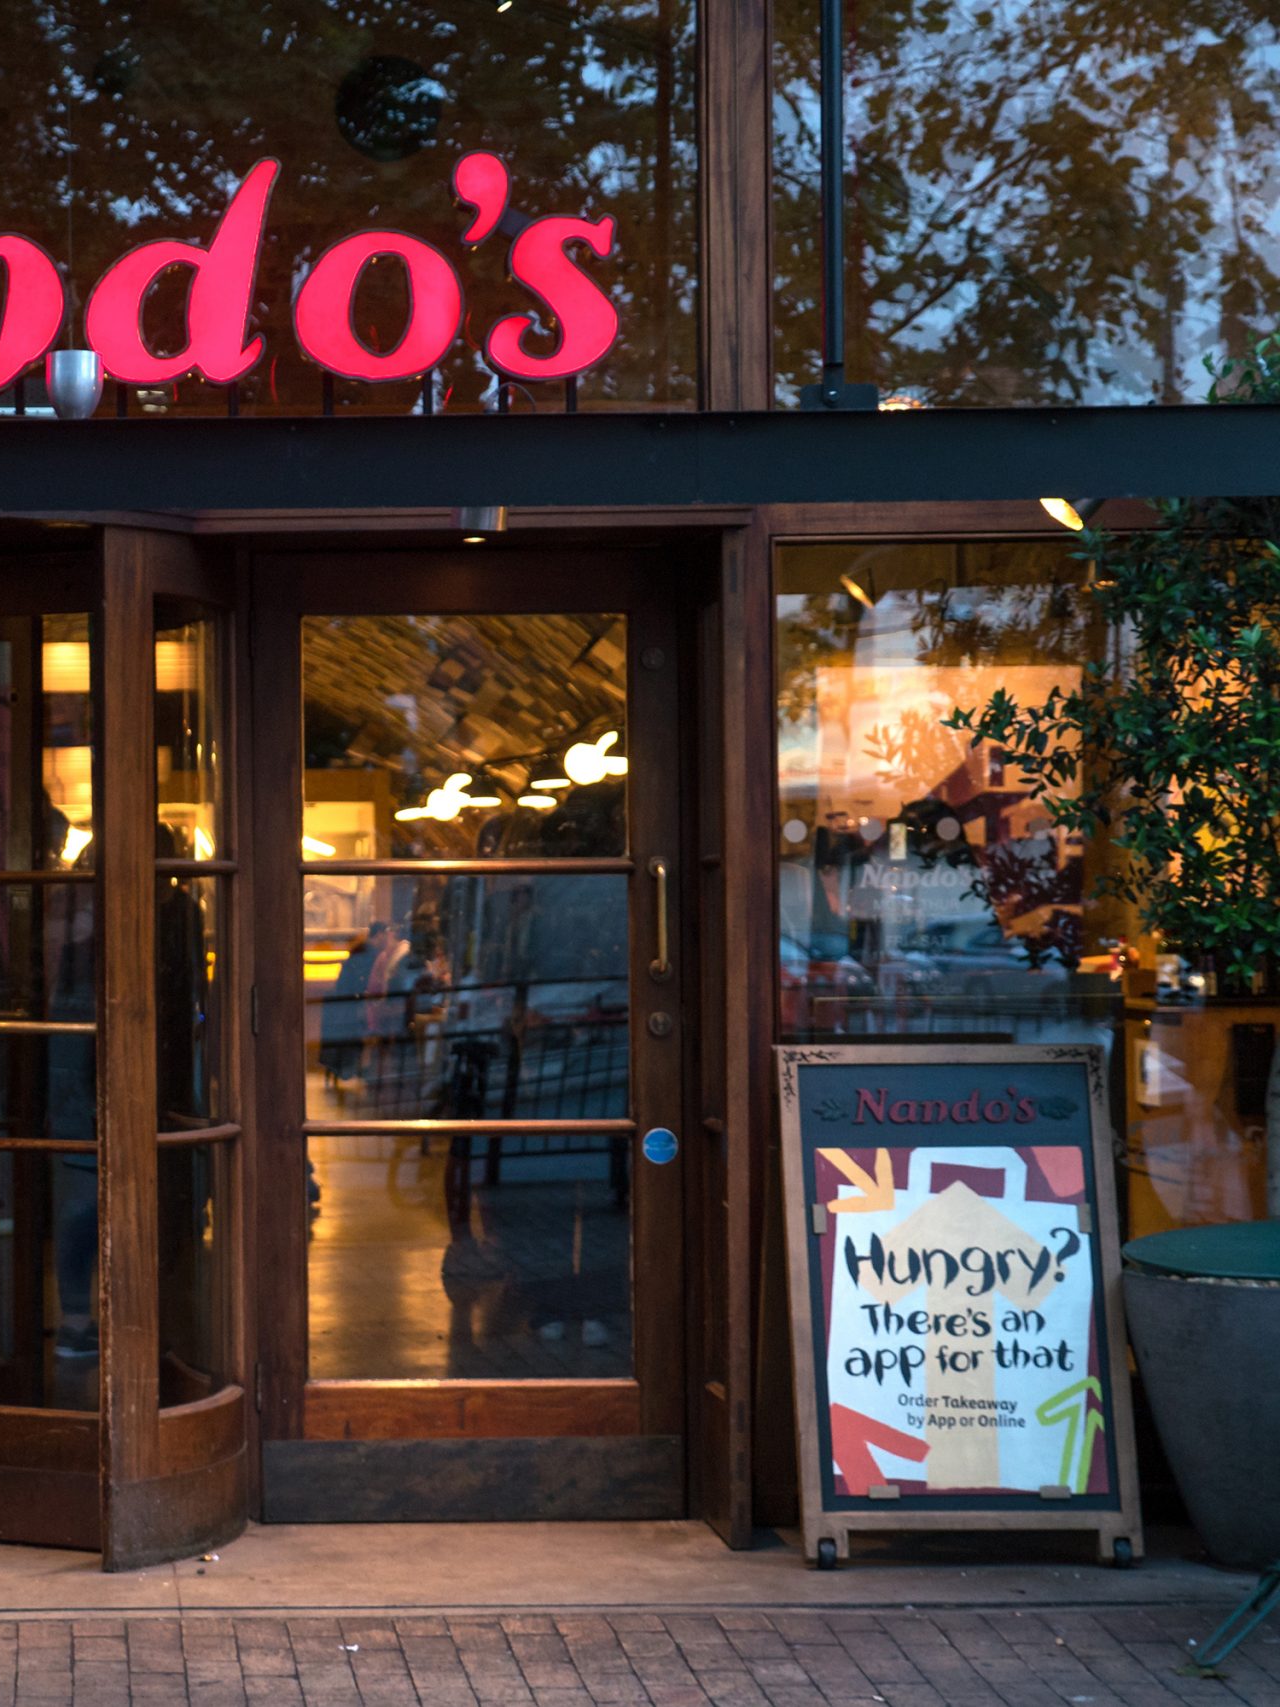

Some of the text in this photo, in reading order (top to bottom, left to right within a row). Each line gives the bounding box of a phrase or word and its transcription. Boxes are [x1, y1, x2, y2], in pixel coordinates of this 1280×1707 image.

[853, 1084, 1037, 1125] Nando's
[844, 1227, 1081, 1296] Hungry?
[860, 1301, 1045, 1338] There's an
[844, 1338, 1075, 1388] app for that
[898, 1393, 1018, 1413] Order Takeaway
[907, 1412, 1026, 1430] by App or Online
